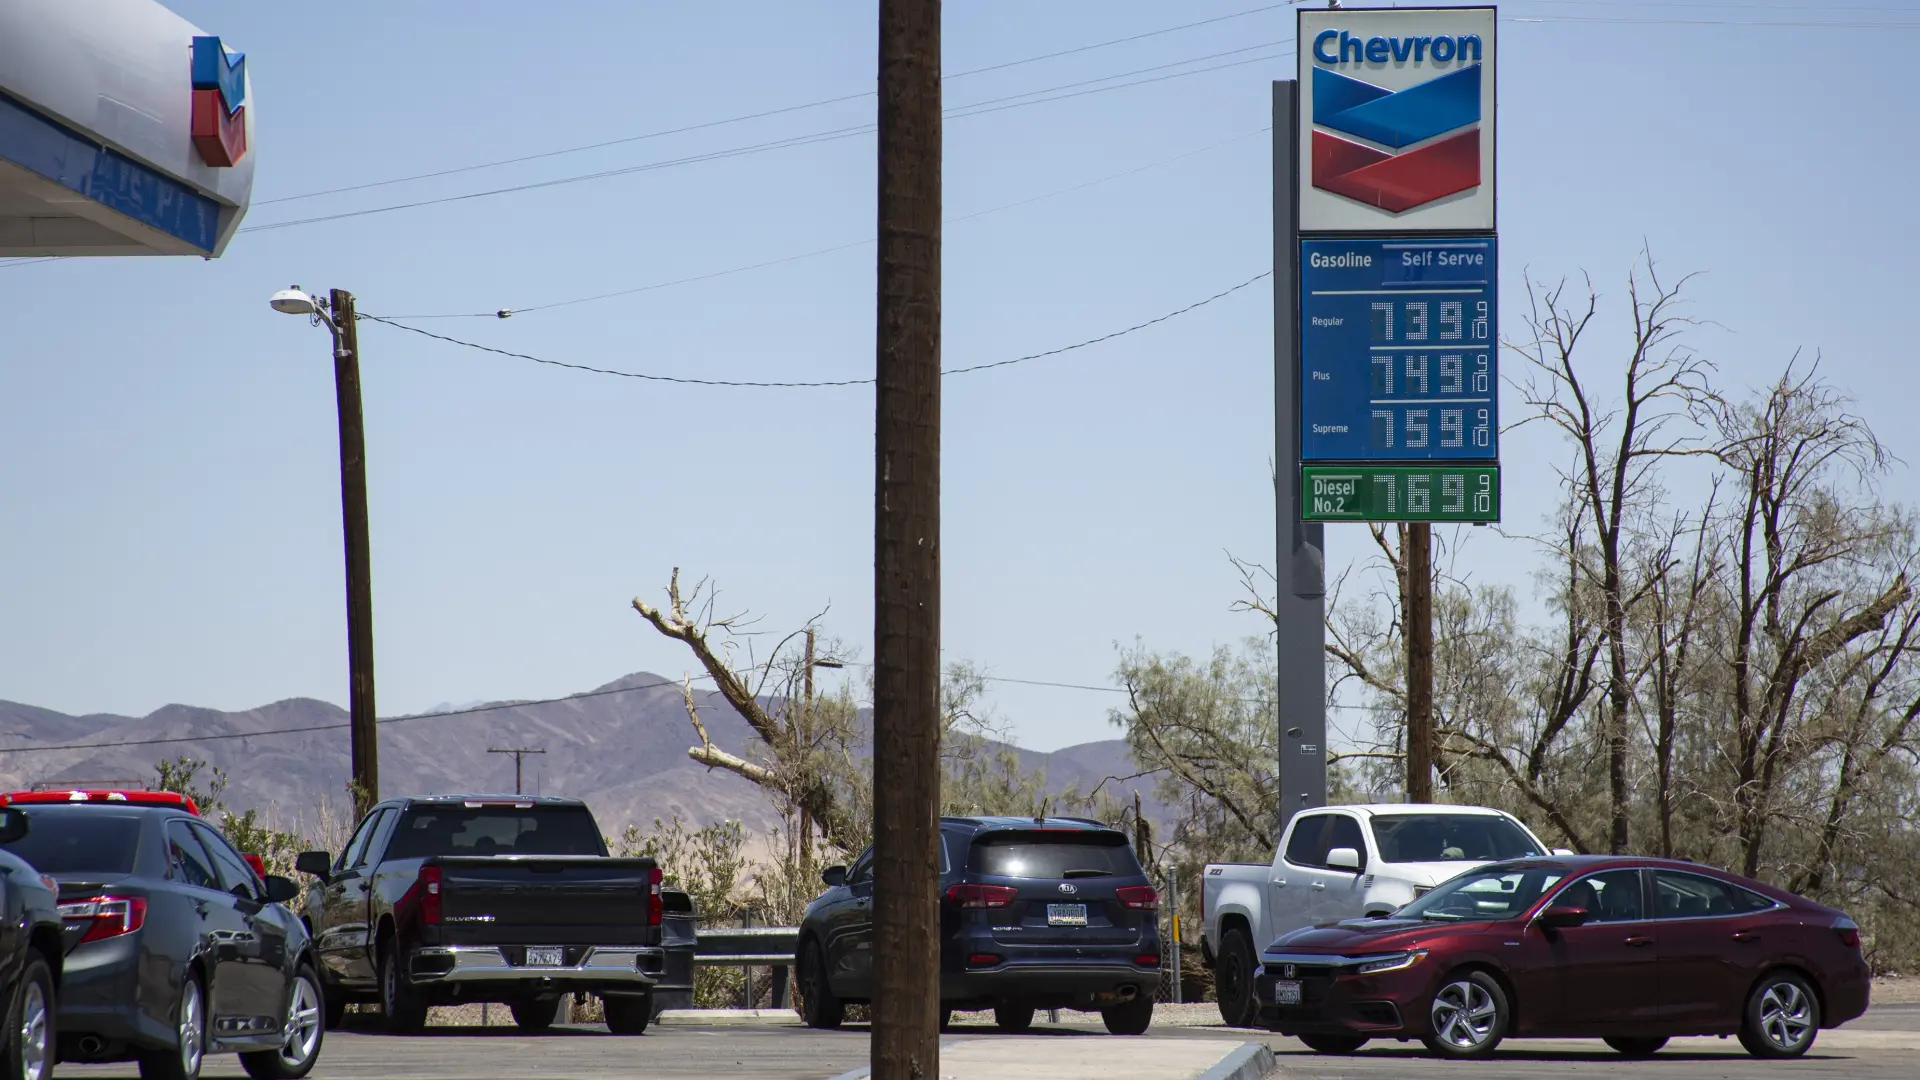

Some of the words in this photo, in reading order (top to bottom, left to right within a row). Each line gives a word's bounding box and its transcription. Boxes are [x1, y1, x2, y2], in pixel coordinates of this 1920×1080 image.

[1313, 29, 1482, 64] Chevron
[1310, 252, 1372, 267] Gasoline
[1402, 251, 1433, 266] Self
[1438, 251, 1484, 266] Serve
[1312, 316, 1344, 328] Regular
[1371, 301, 1462, 340] 739
[1312, 371, 1330, 380] Plus
[1371, 355, 1462, 393] 749
[1312, 424, 1349, 434] Supreme
[1372, 409, 1463, 448] 759
[1314, 479, 1355, 495] Diesel
[1373, 474, 1465, 513] 769
[1314, 497, 1345, 513] No.2
[1060, 884, 1075, 893] KIA
